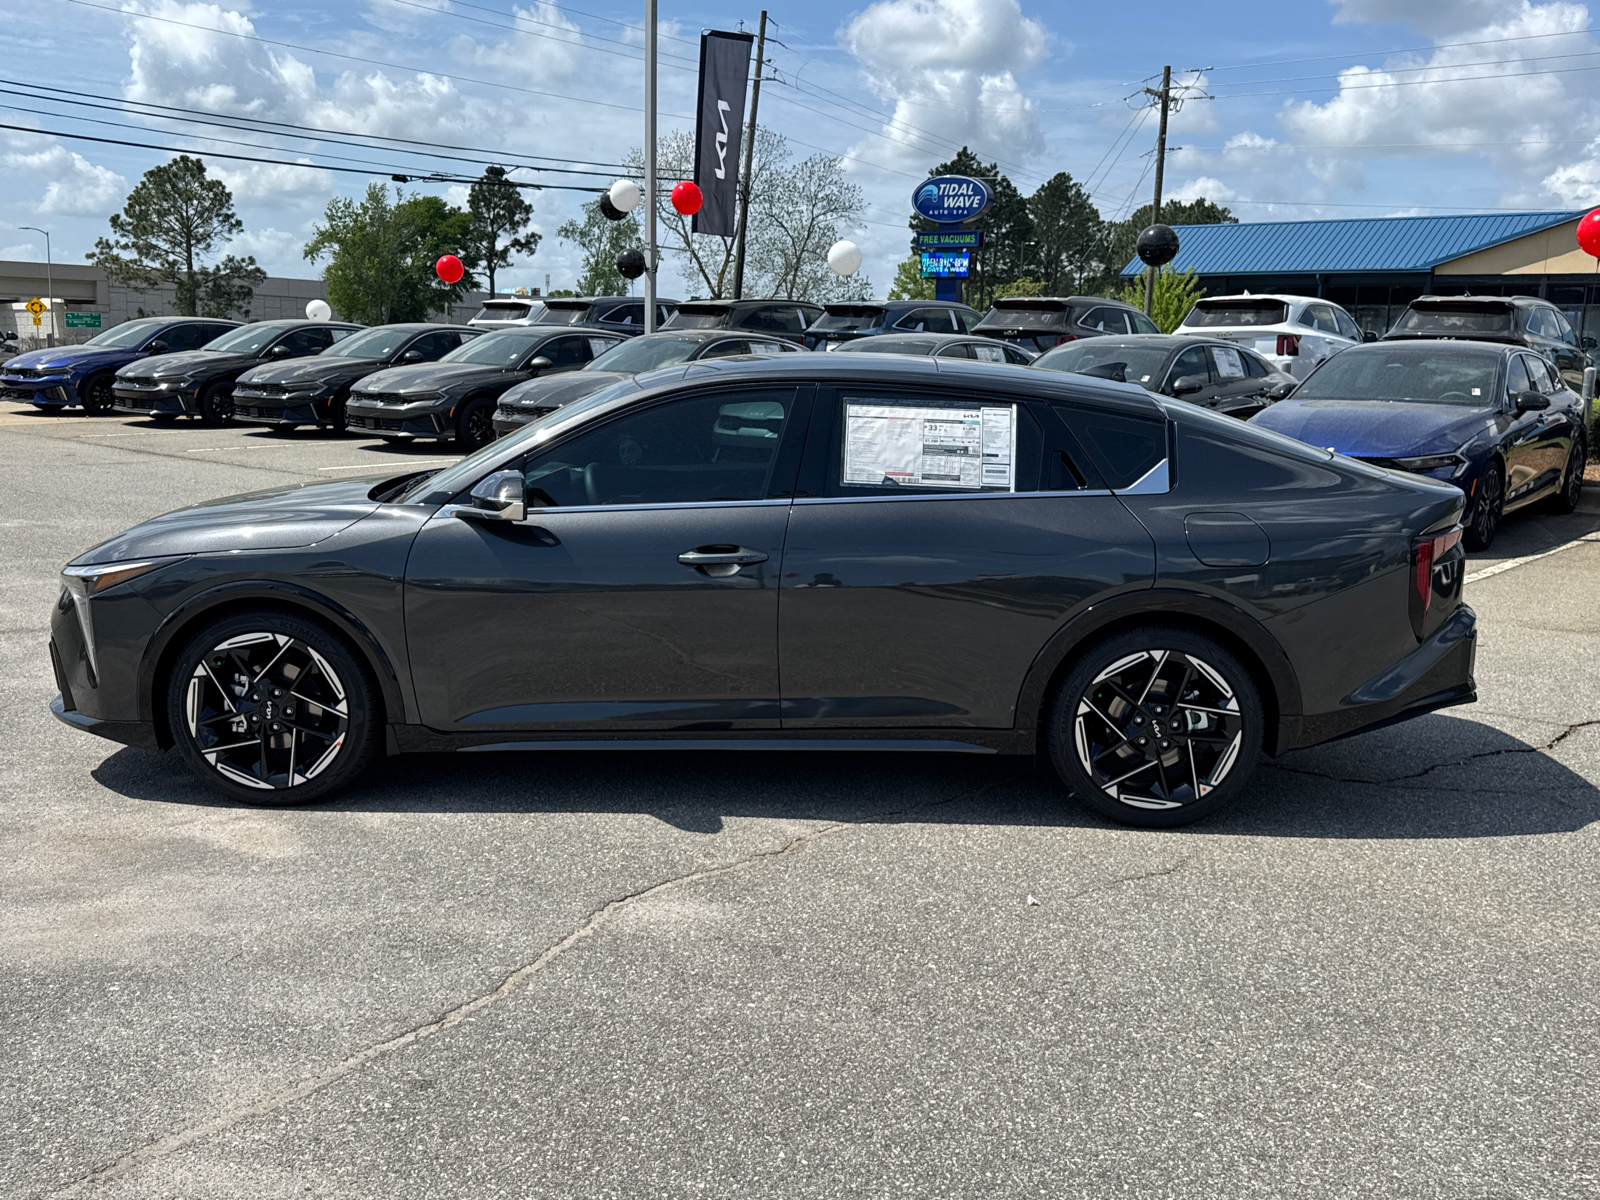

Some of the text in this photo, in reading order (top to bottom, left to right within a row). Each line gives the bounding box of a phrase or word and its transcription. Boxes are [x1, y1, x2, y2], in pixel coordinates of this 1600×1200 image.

[714, 99, 731, 180] KIA
[938, 183, 974, 196] TIDAL
[943, 195, 981, 208] WAVE
[919, 234, 976, 244] FREE VACUUMS
[279, 620, 328, 648] KUMHO
[1060, 685, 1079, 734] KUMHO
